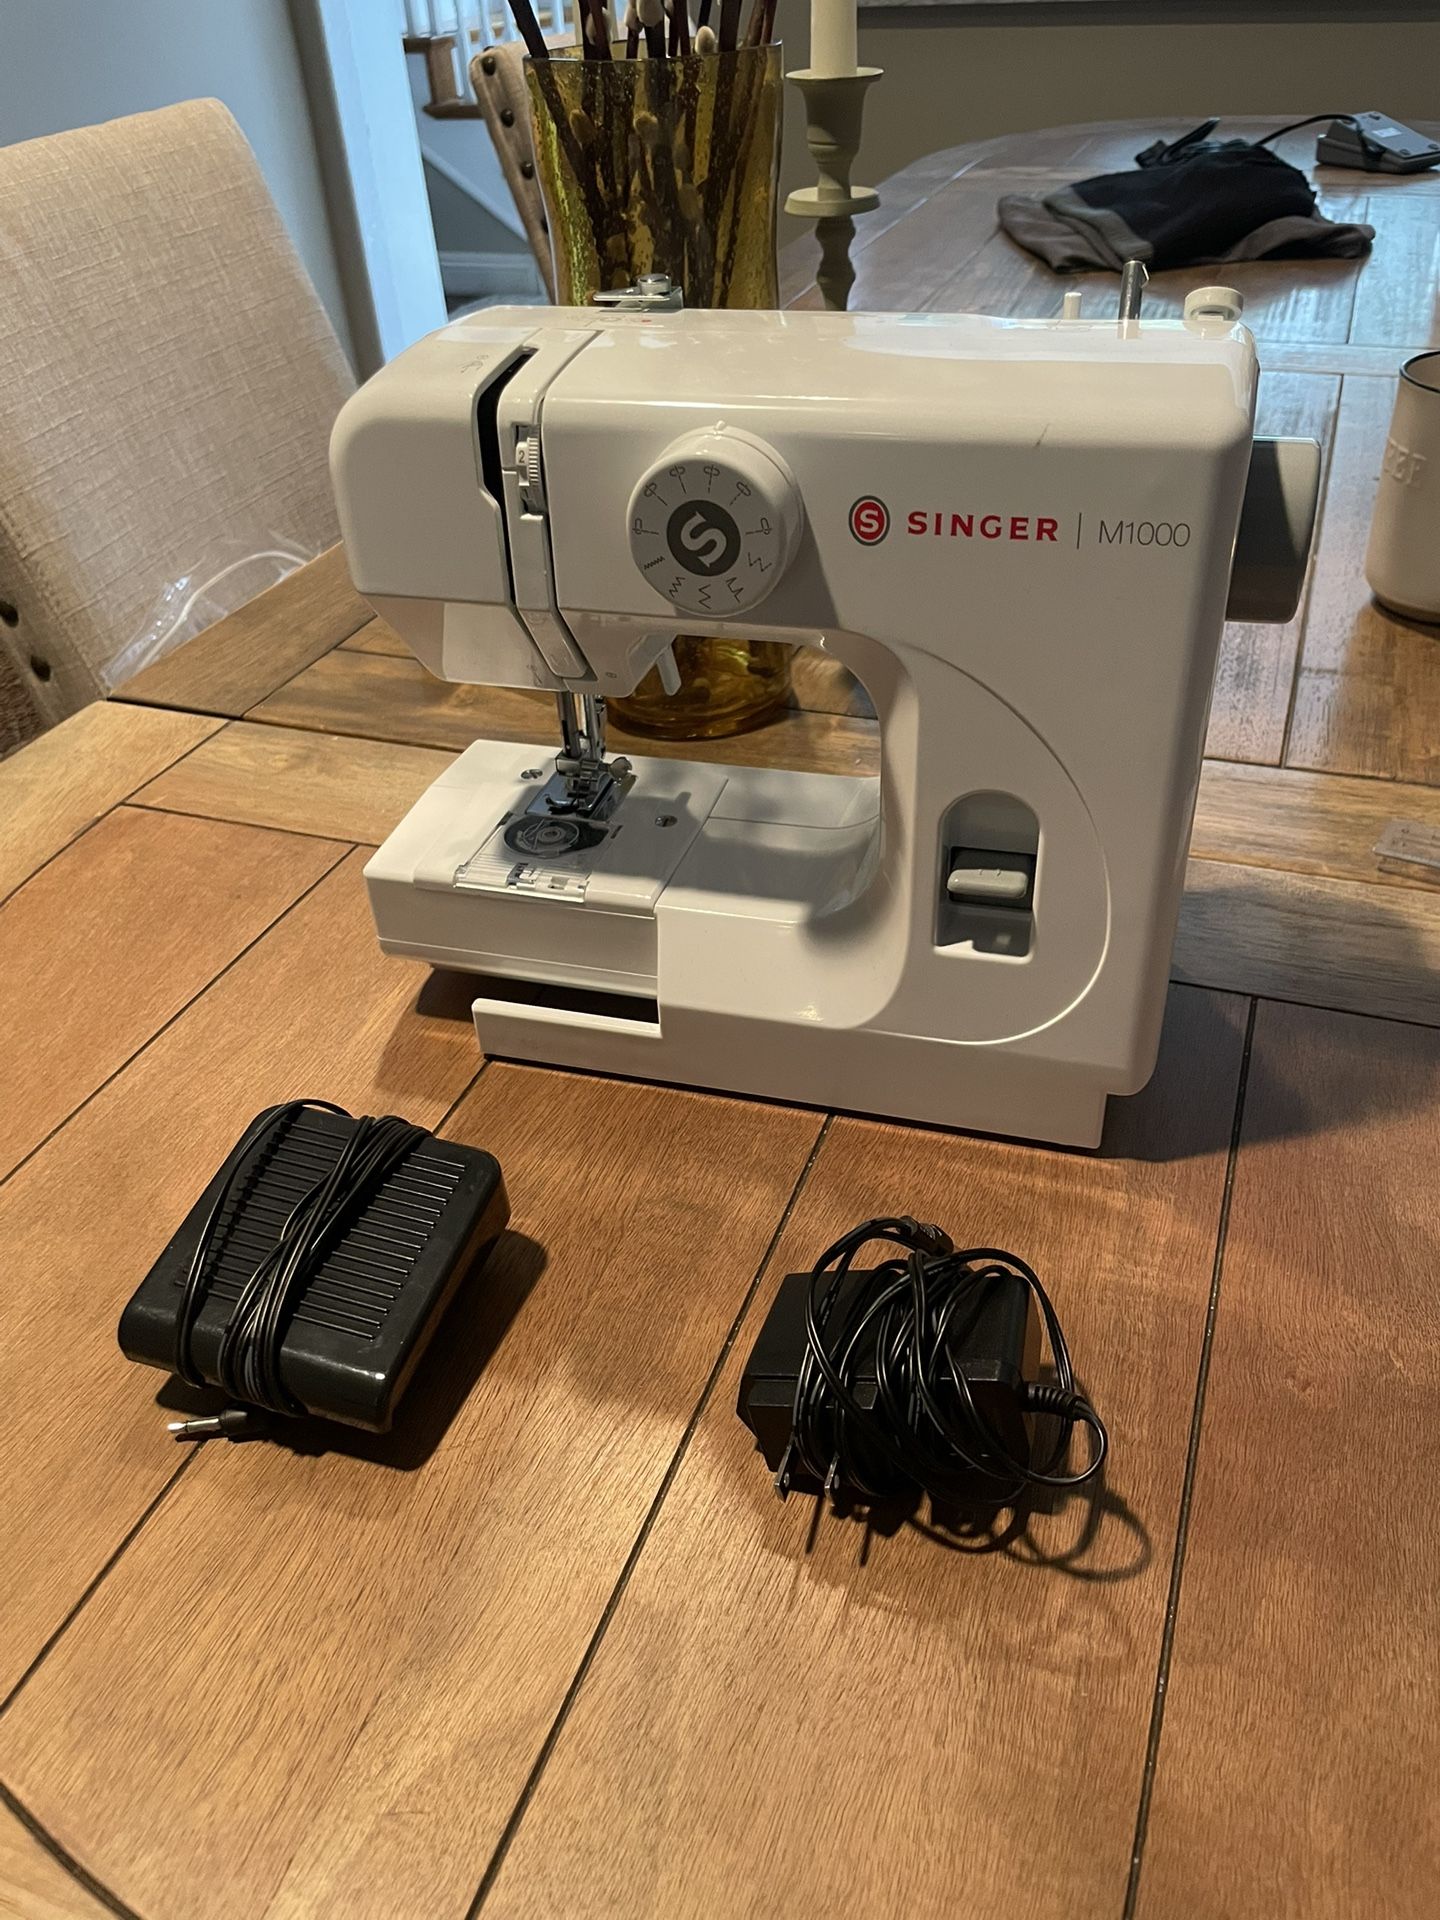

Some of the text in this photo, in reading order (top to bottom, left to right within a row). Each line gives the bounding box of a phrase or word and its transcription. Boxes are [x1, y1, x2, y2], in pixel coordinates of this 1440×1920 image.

[518, 449, 525, 464] 2
[681, 510, 727, 568] S
[907, 511, 1058, 542] SINGER
[1098, 520, 1191, 547] M1000
